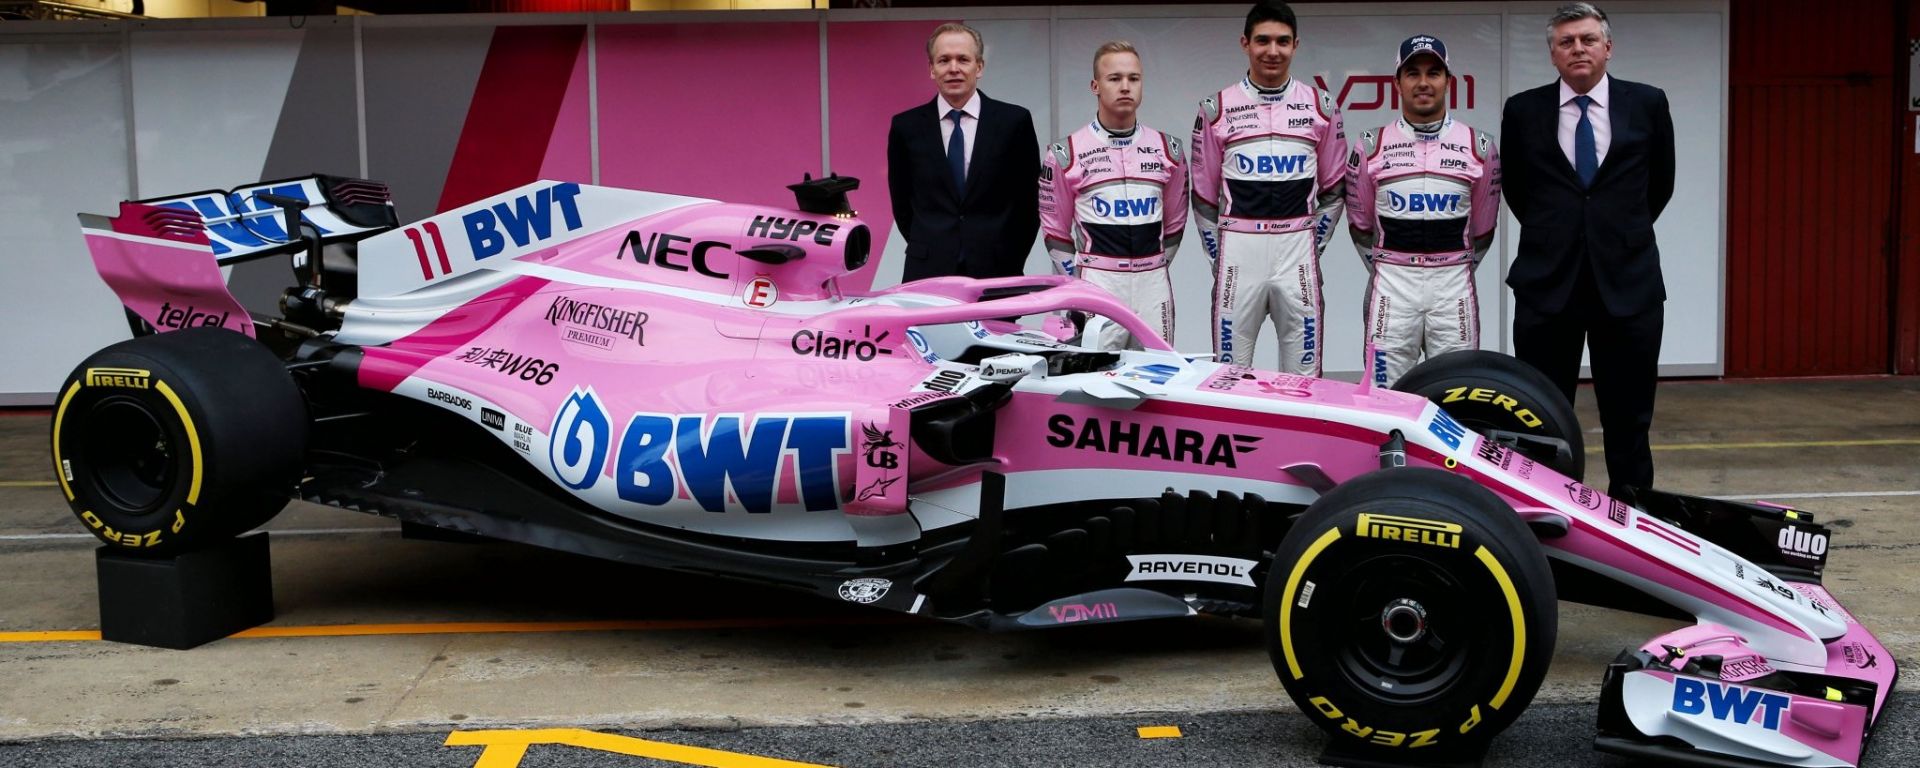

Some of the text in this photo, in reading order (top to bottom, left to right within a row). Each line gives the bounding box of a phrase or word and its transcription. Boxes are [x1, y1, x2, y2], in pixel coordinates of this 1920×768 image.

[1225, 105, 1254, 114] SAHARA
[1288, 118, 1314, 127] HYPE
[1078, 147, 1107, 160] SAHARA
[1383, 143, 1413, 152] SAHARA
[1440, 143, 1470, 154] NEC
[1141, 163, 1165, 171] HYPE
[1258, 155, 1308, 174] BWT
[1440, 159, 1468, 169] HYPE
[1113, 197, 1158, 218] BWT
[1409, 194, 1461, 213] BWT
[462, 182, 583, 261] BWT
[747, 215, 840, 246] HYPE
[405, 222, 453, 281] 11
[616, 230, 732, 279] NEC
[749, 280, 770, 307] E
[1223, 265, 1234, 309] MAGNESIUM
[1298, 264, 1310, 307] MAGNESIUM
[157, 302, 229, 328] telcel
[544, 296, 649, 346] KINGFISHER
[1458, 298, 1467, 341] MAGNESIUM
[567, 330, 610, 347] PREMIUM
[791, 330, 877, 361] Claro
[1221, 319, 1233, 351] BWT
[1304, 317, 1315, 350] BWT
[86, 367, 150, 389] PIRELLI
[995, 367, 1024, 375] PEMEX
[427, 388, 472, 411] BARBADOS
[1442, 386, 1543, 428] ZERO
[481, 410, 504, 428] UNIVA
[514, 422, 533, 436] BLUE
[1046, 413, 1237, 469] SAHARA
[617, 415, 847, 514] BWT
[81, 509, 164, 548] ZERO
[1356, 512, 1463, 549] PIRELLI
[1778, 524, 1828, 556] duo
[1138, 561, 1243, 578] RAVENOL
[1672, 678, 1790, 731] BWT
[1308, 695, 1441, 748] ZERO
